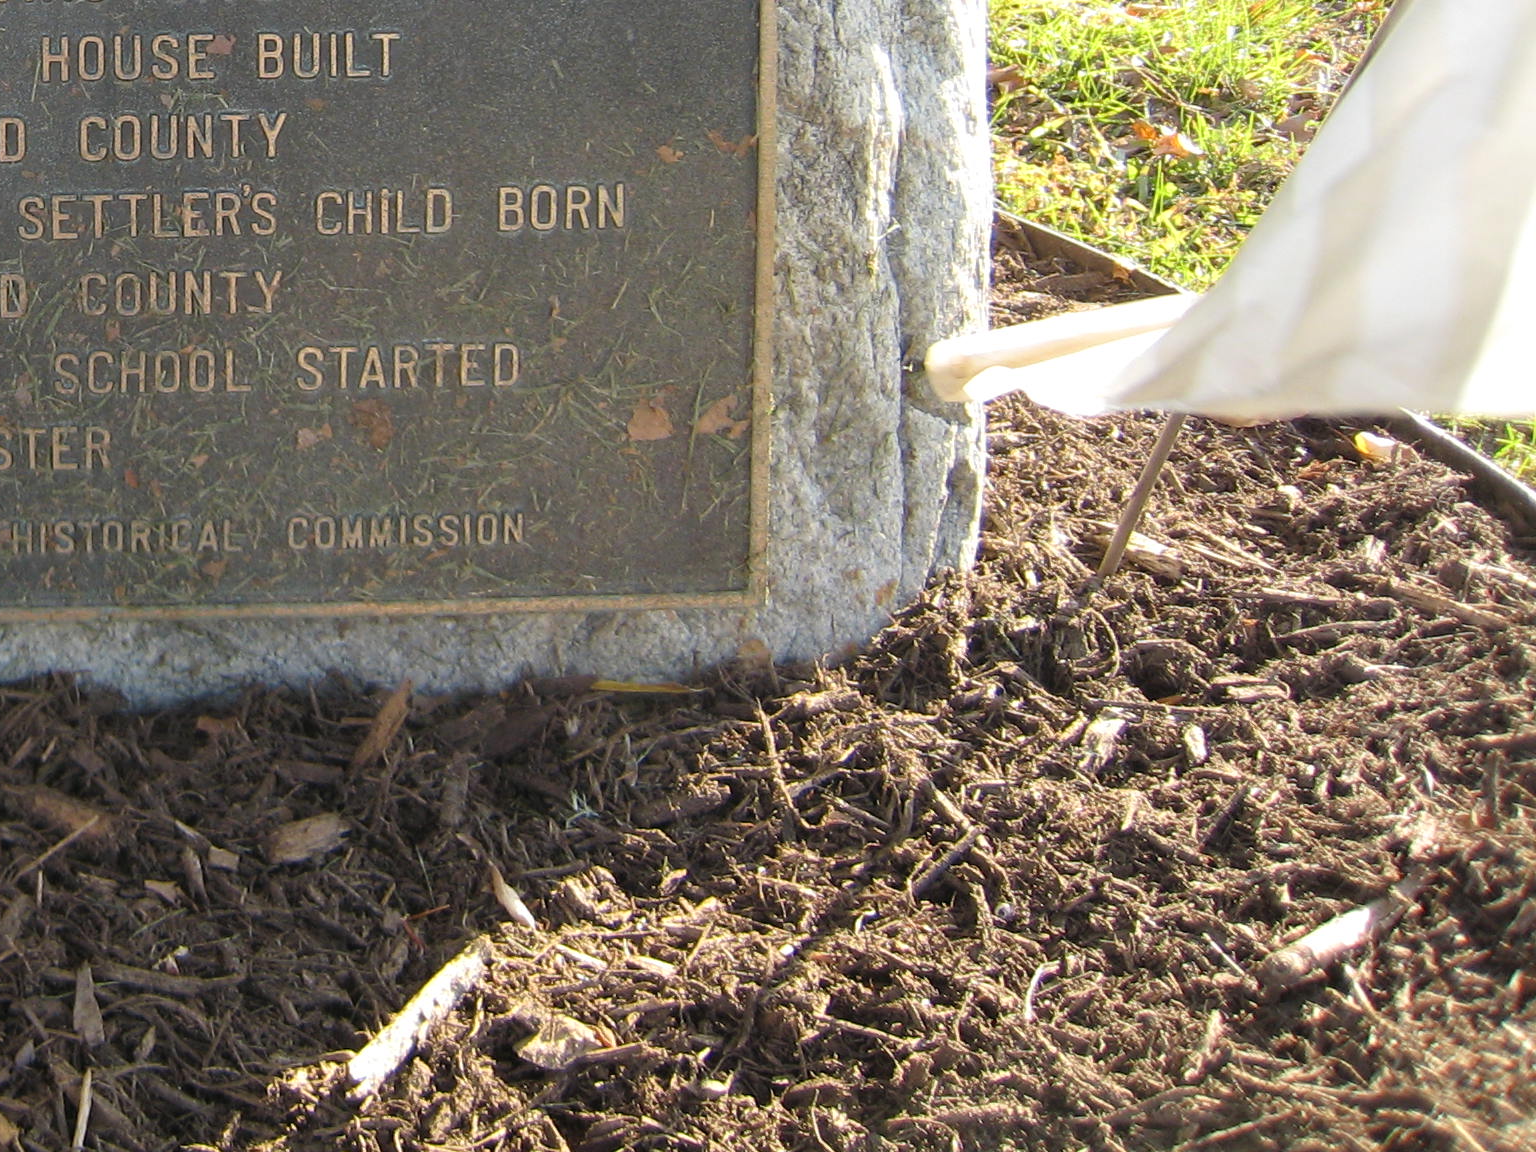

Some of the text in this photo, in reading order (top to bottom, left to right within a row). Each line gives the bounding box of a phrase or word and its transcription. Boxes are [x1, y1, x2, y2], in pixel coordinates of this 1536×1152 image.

[41, 34, 216, 84] HOUSE
[257, 31, 402, 79] BUILT
[78, 112, 287, 162] COUNTY
[18, 185, 278, 242] SETTLER'S
[315, 187, 453, 236] CHILD
[498, 183, 627, 232] BORN
[78, 270, 283, 317] COUNTY
[53, 349, 252, 396] SCHOOL
[296, 343, 521, 390] STARTED
[11, 517, 242, 555] HISTORICAL
[286, 512, 526, 551] COMMISSION
